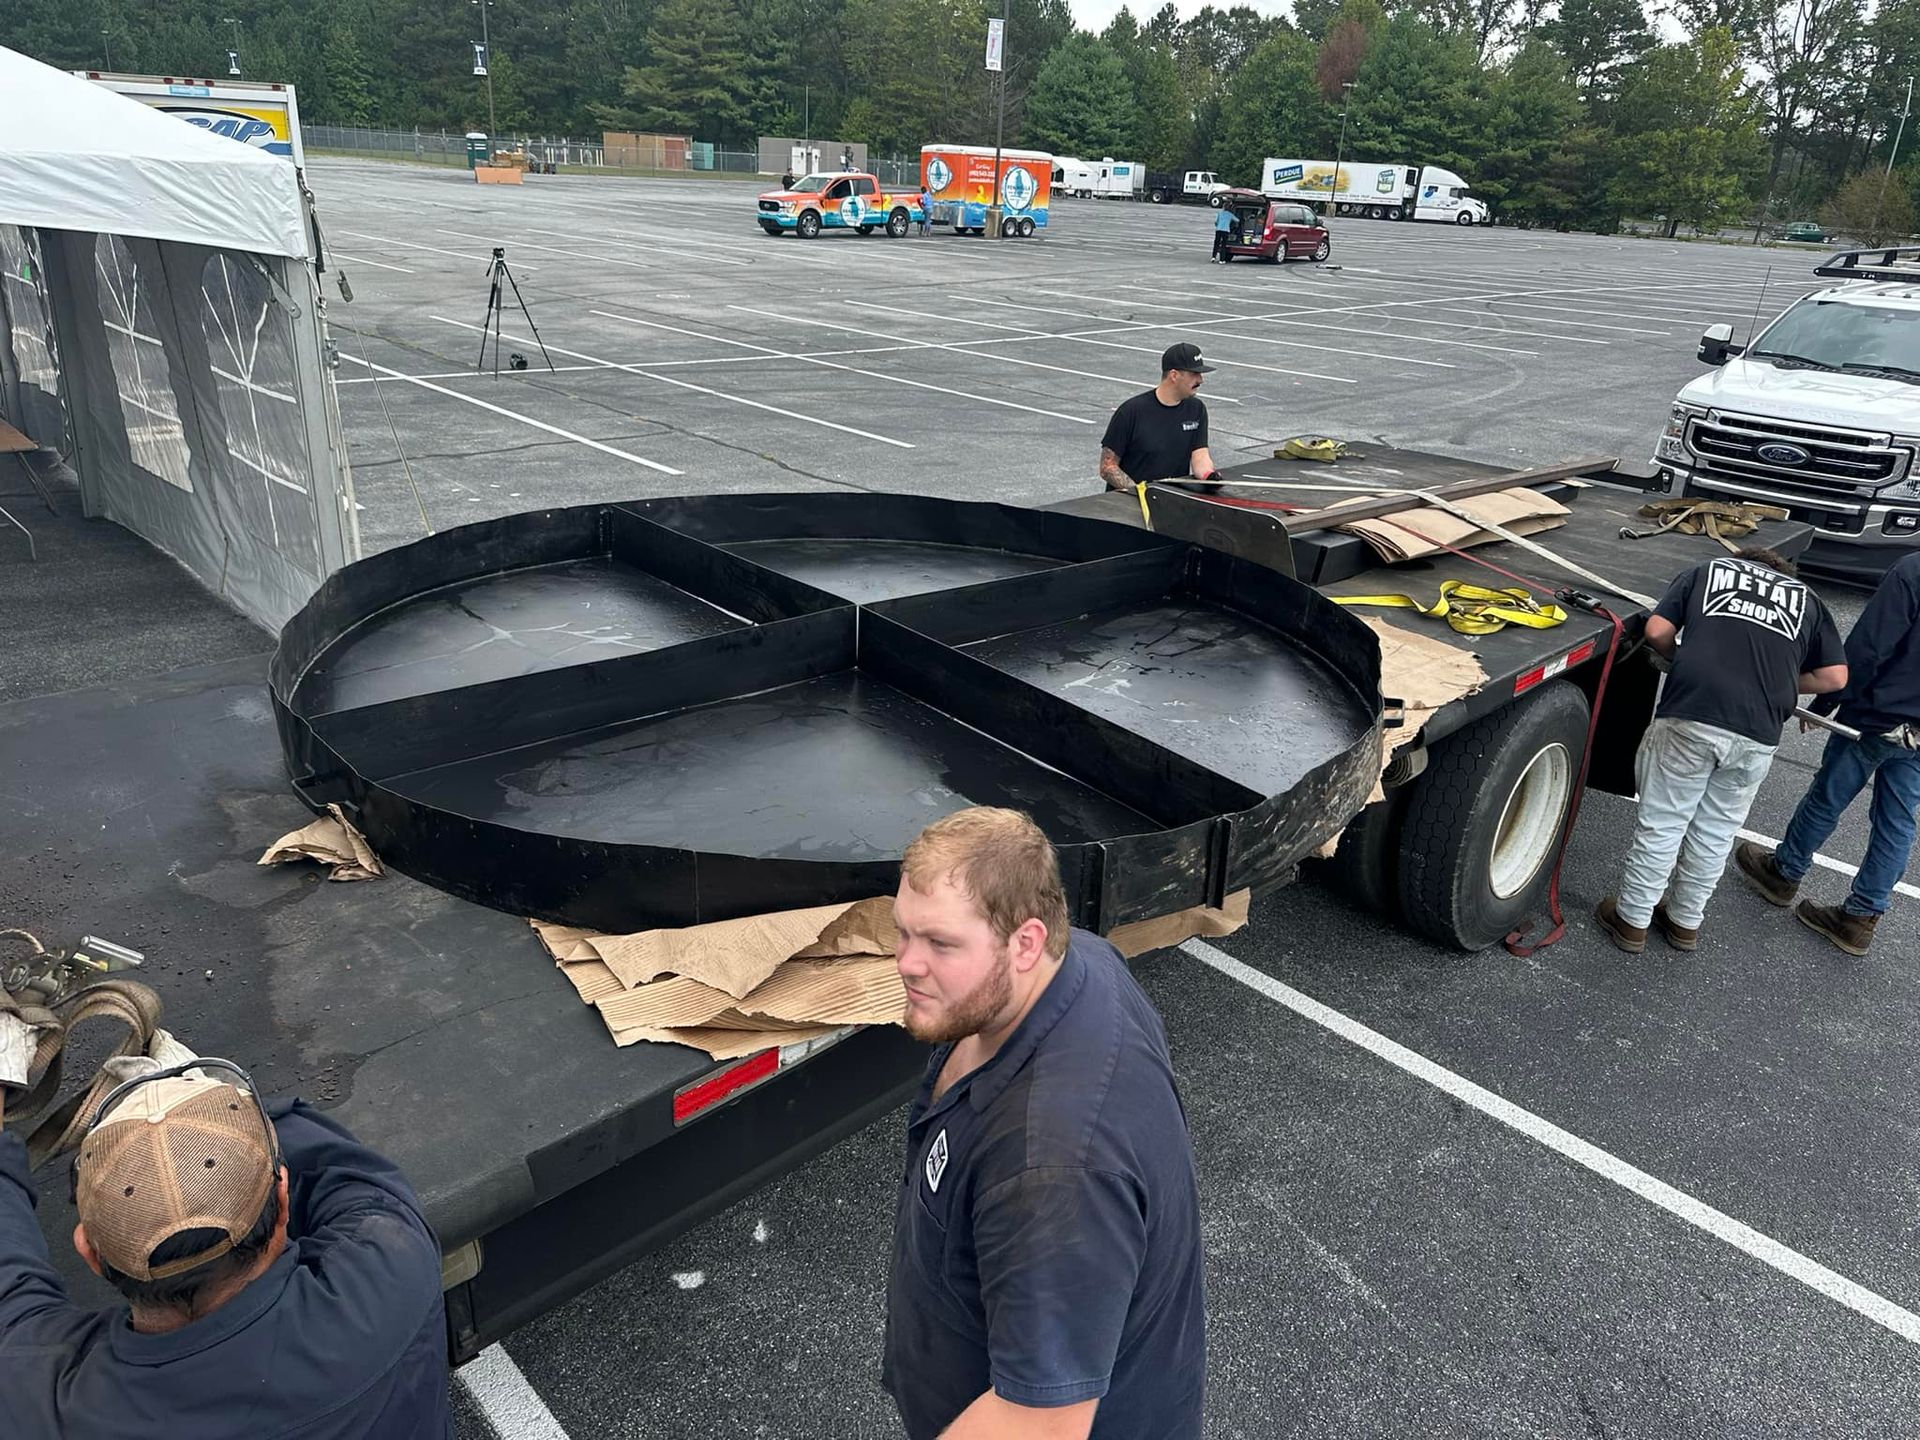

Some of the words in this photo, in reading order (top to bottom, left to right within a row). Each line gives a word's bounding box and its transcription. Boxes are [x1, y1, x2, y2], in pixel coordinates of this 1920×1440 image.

[1275, 167, 1301, 180] PERDUE
[1768, 448, 1797, 461] Ford
[1741, 562, 1776, 581] THE
[1711, 568, 1799, 619] METAL
[1727, 598, 1778, 625] SHOP
